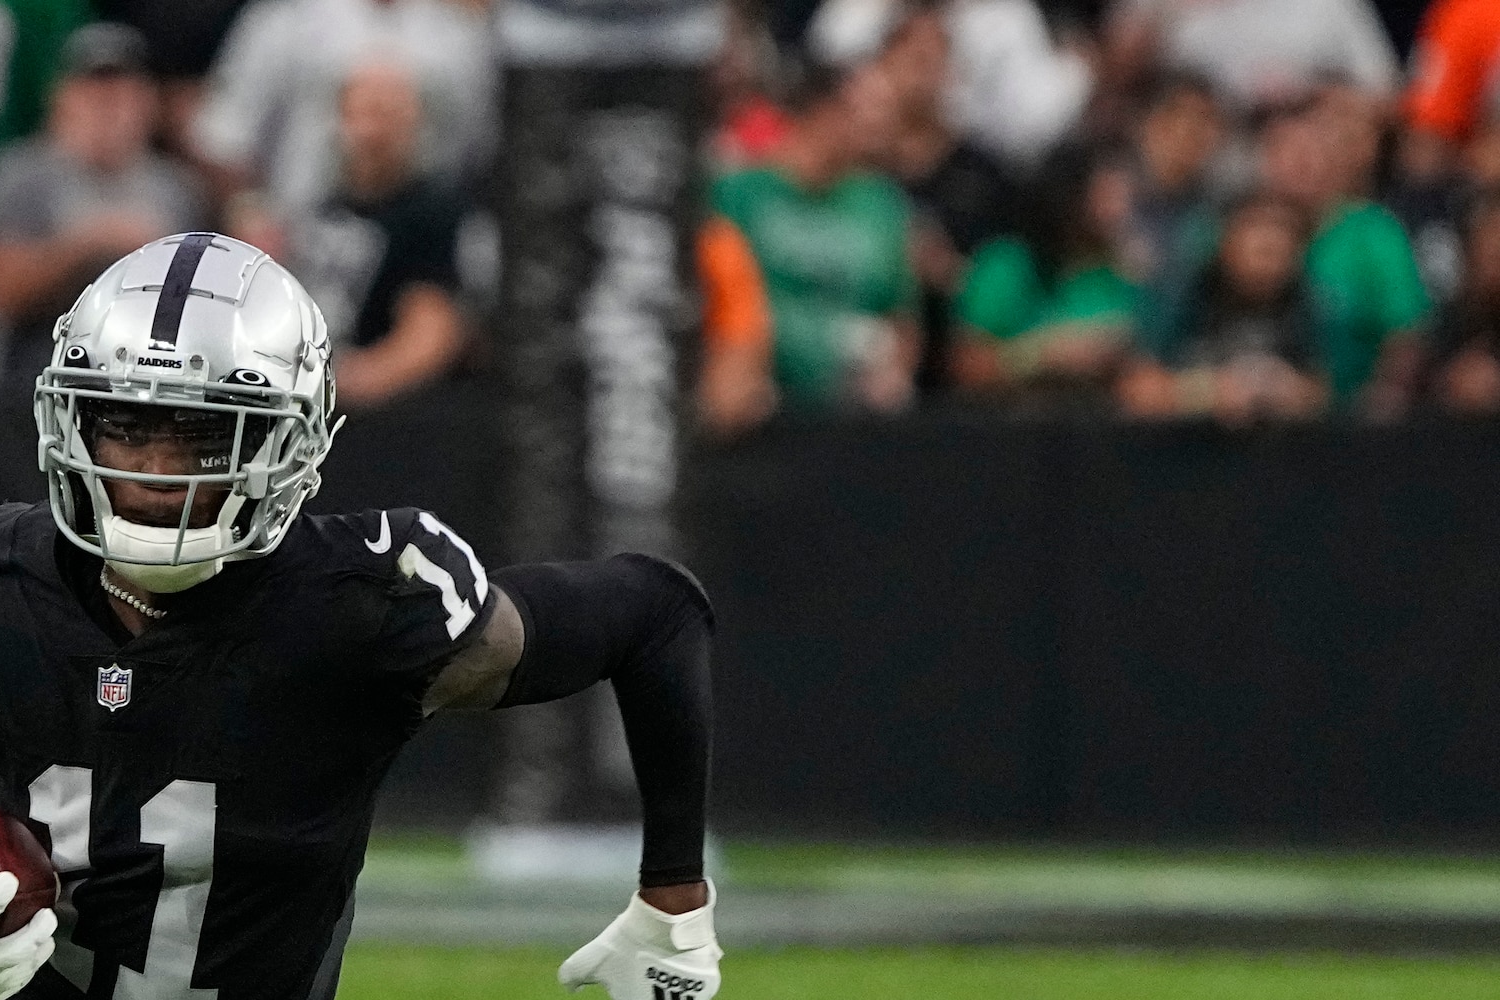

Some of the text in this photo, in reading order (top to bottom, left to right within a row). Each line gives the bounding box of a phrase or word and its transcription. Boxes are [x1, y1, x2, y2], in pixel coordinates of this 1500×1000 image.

[137, 356, 183, 369] RAIDERS
[200, 454, 232, 468] KENZ
[102, 684, 126, 703] NFL
